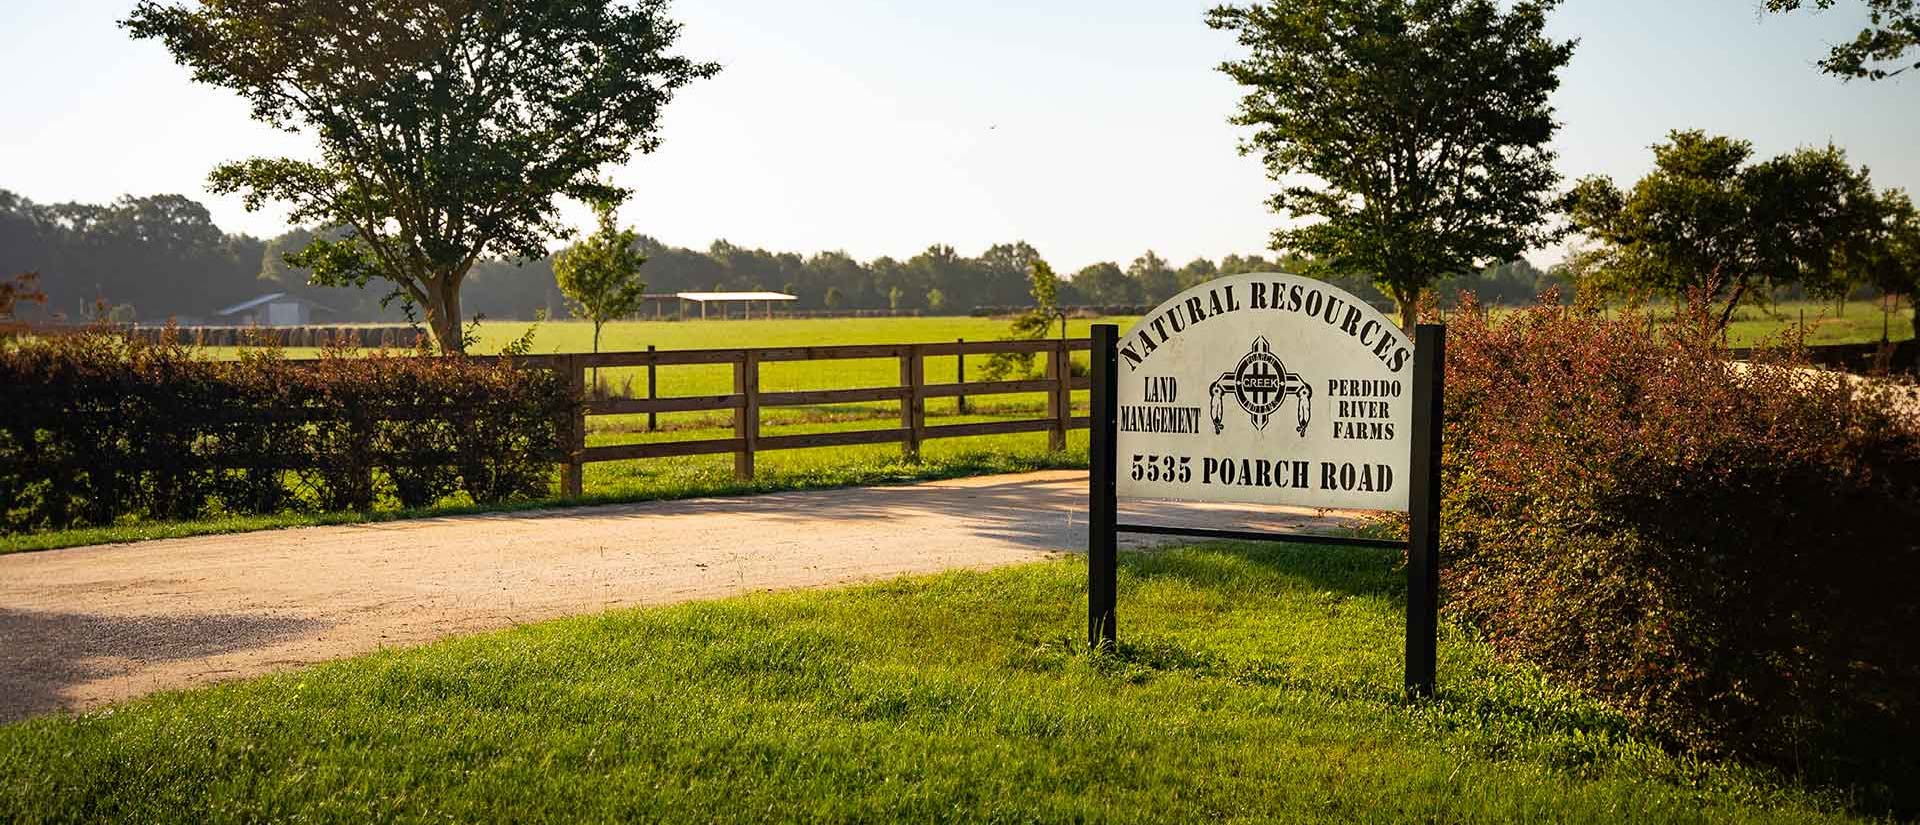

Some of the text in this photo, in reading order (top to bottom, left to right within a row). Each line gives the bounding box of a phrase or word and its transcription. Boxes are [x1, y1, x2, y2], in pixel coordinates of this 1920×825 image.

[1120, 282, 1411, 373] NATURAL RESOURCES
[1144, 376, 1177, 403] LAND
[1244, 379, 1279, 388] CREEK
[1328, 379, 1402, 398] PERDIDO
[1120, 405, 1201, 434] MANAGEMENT
[1338, 400, 1390, 419] RIVER
[1333, 421, 1394, 441] FARMS
[1131, 454, 1394, 493] 5535 POARCH ROAD
